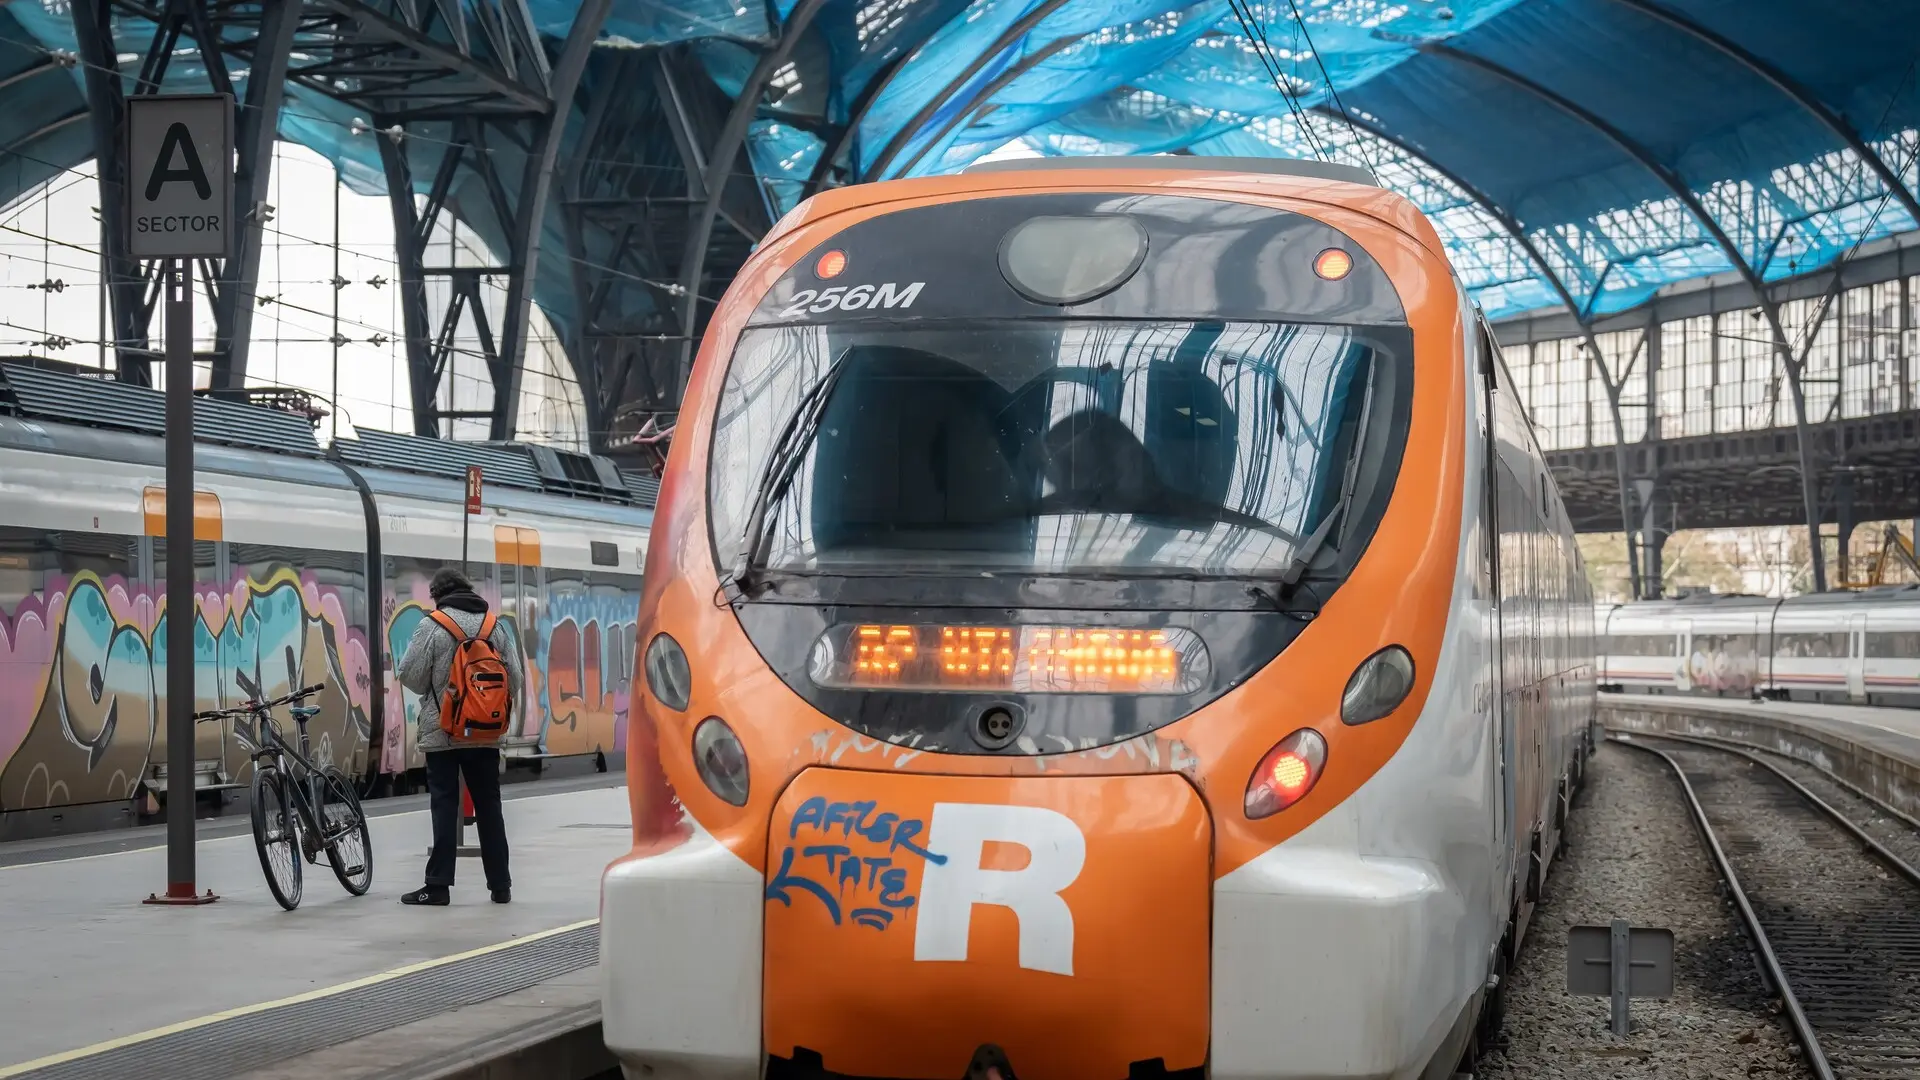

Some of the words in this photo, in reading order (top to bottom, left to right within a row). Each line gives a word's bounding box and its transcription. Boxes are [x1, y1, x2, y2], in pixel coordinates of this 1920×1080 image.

[144, 121, 212, 202] A
[137, 215, 220, 232] SECTOR
[778, 282, 926, 318] 256M
[914, 802, 1086, 977] R
